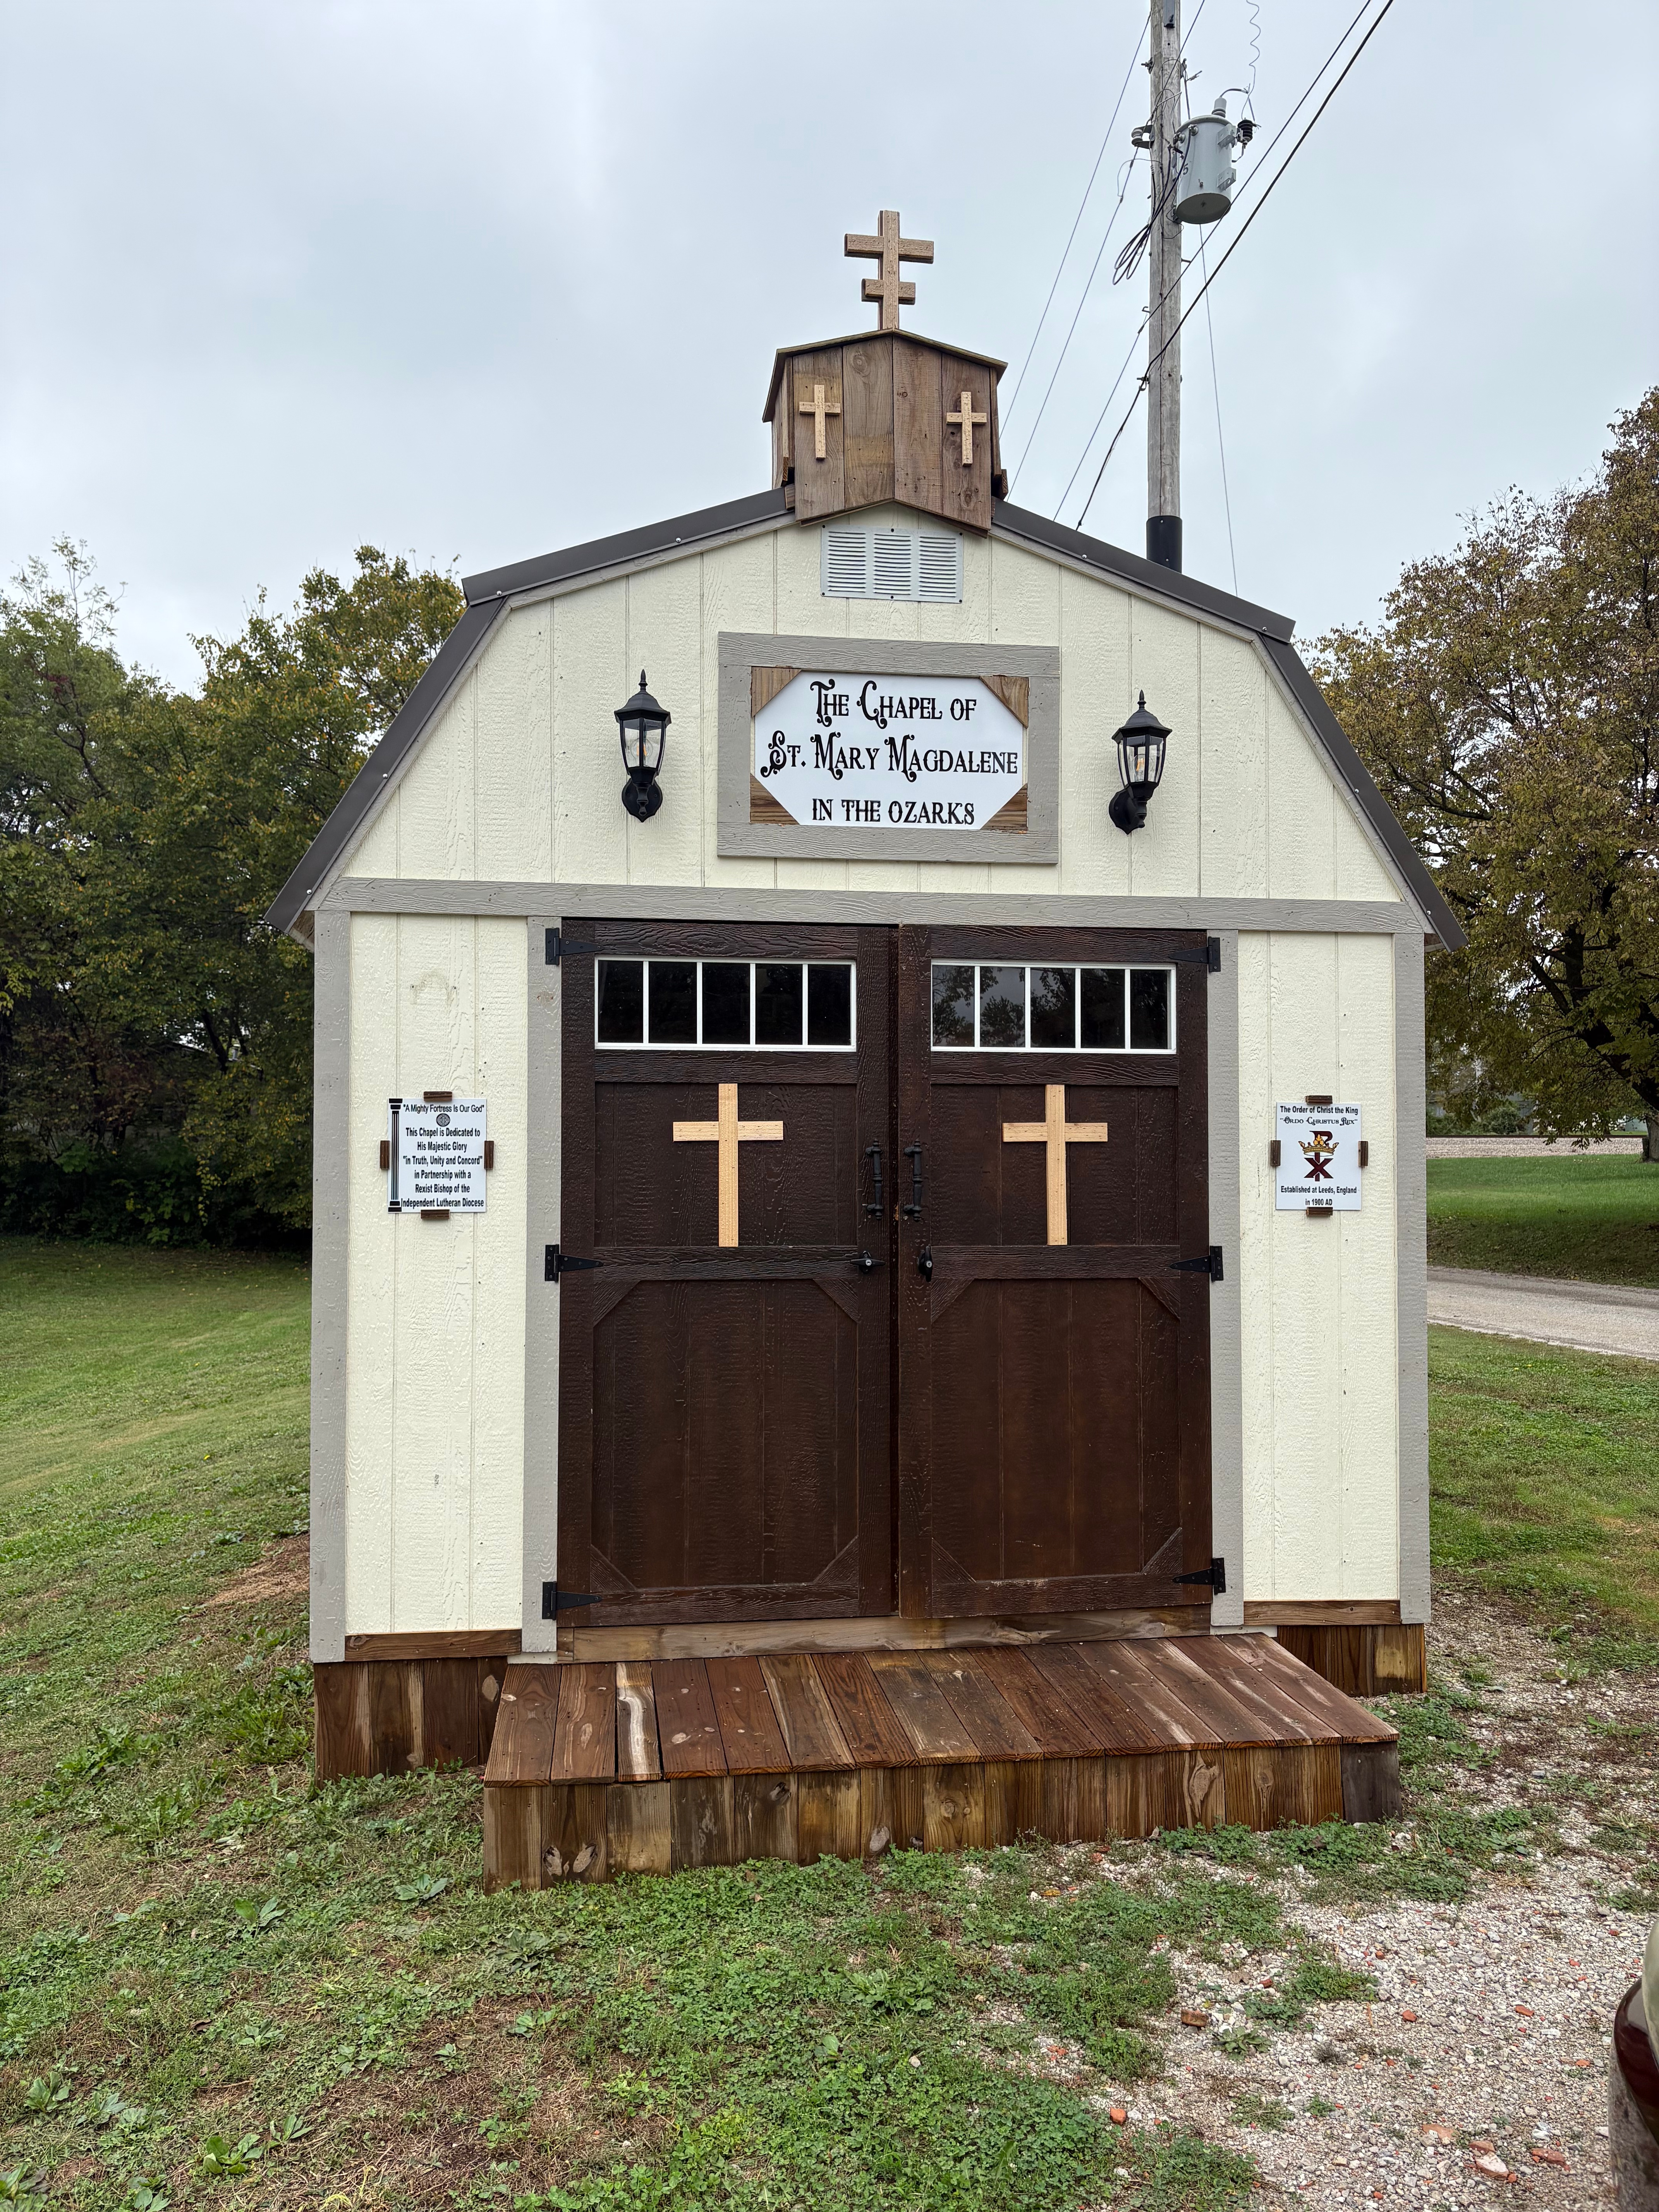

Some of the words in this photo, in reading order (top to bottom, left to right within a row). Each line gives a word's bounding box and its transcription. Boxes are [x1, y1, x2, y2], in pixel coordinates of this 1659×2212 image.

[812, 799, 833, 821] IN
[841, 800, 881, 822] THE
[888, 801, 974, 825] OZARKS
[411, 1104, 428, 1114] Mighty
[1346, 1107, 1358, 1115] King
[406, 1127, 417, 1136] This
[419, 1128, 438, 1139] Chapel
[440, 1128, 444, 1136] is
[446, 1128, 473, 1136] Dedicated
[475, 1128, 480, 1137] to
[417, 1142, 426, 1150] His
[428, 1142, 451, 1153] Majestic
[453, 1142, 467, 1153] Glory
[412, 1156, 428, 1166] Truth,
[430, 1156, 444, 1167] Unity
[446, 1156, 455, 1164] and
[415, 1170, 419, 1178] in
[421, 1170, 453, 1181] Partnership
[454, 1170, 466, 1178] with
[416, 1184, 432, 1193] Rexist
[434, 1184, 452, 1195] Bishop
[454, 1184, 459, 1192] of
[461, 1184, 470, 1192] the
[1319, 1186, 1335, 1194] Leeds,
[1337, 1187, 1357, 1195] England
[401, 1198, 434, 1209] Independent
[437, 1198, 460, 1207] Lutheran
[463, 1198, 484, 1207] Diocese
